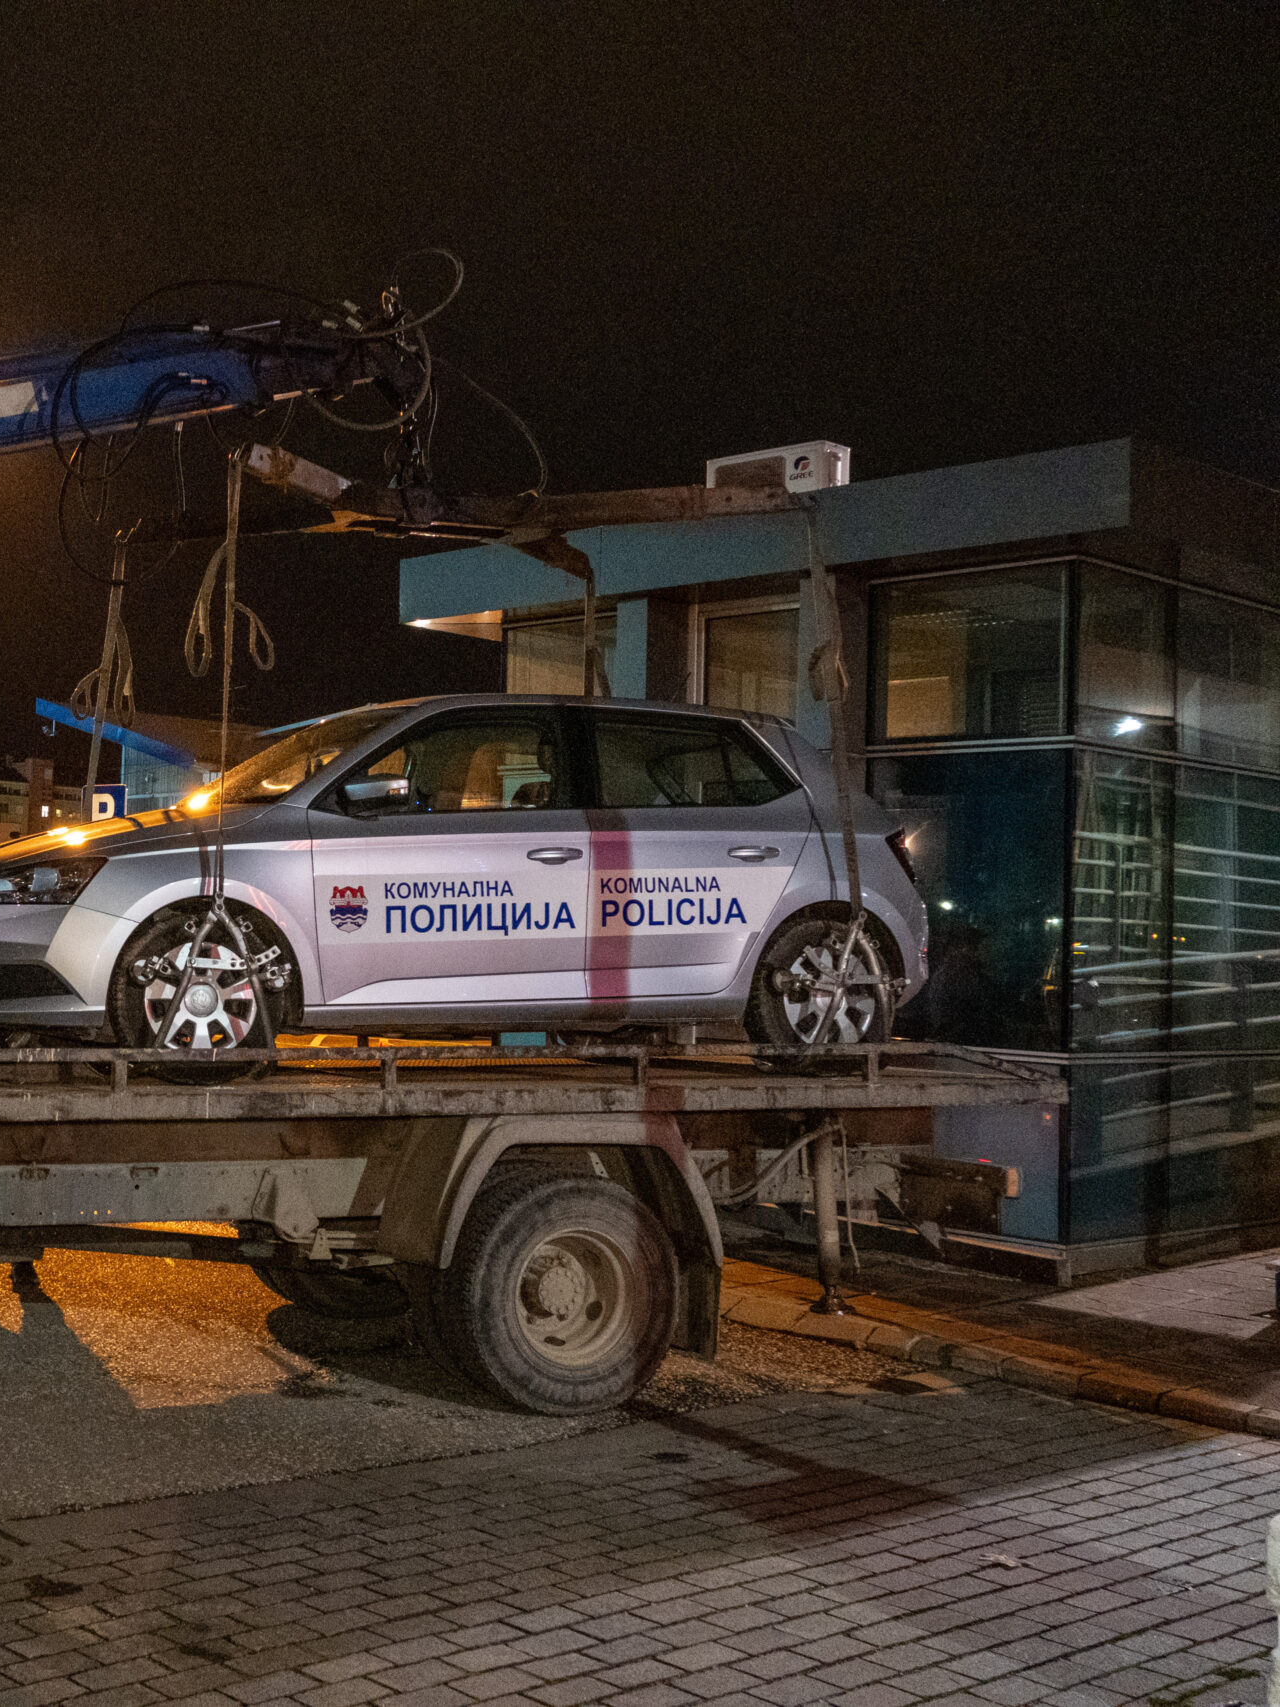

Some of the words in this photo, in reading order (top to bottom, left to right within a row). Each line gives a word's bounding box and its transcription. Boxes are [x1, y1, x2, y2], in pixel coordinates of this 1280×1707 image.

[789, 471, 814, 481] GREE
[384, 880, 513, 899] КОМУНАЛНА
[600, 876, 721, 894] KOMUNALNA
[385, 902, 576, 936] ПОЛИЦИЈА
[601, 897, 748, 927] POLICIJA
